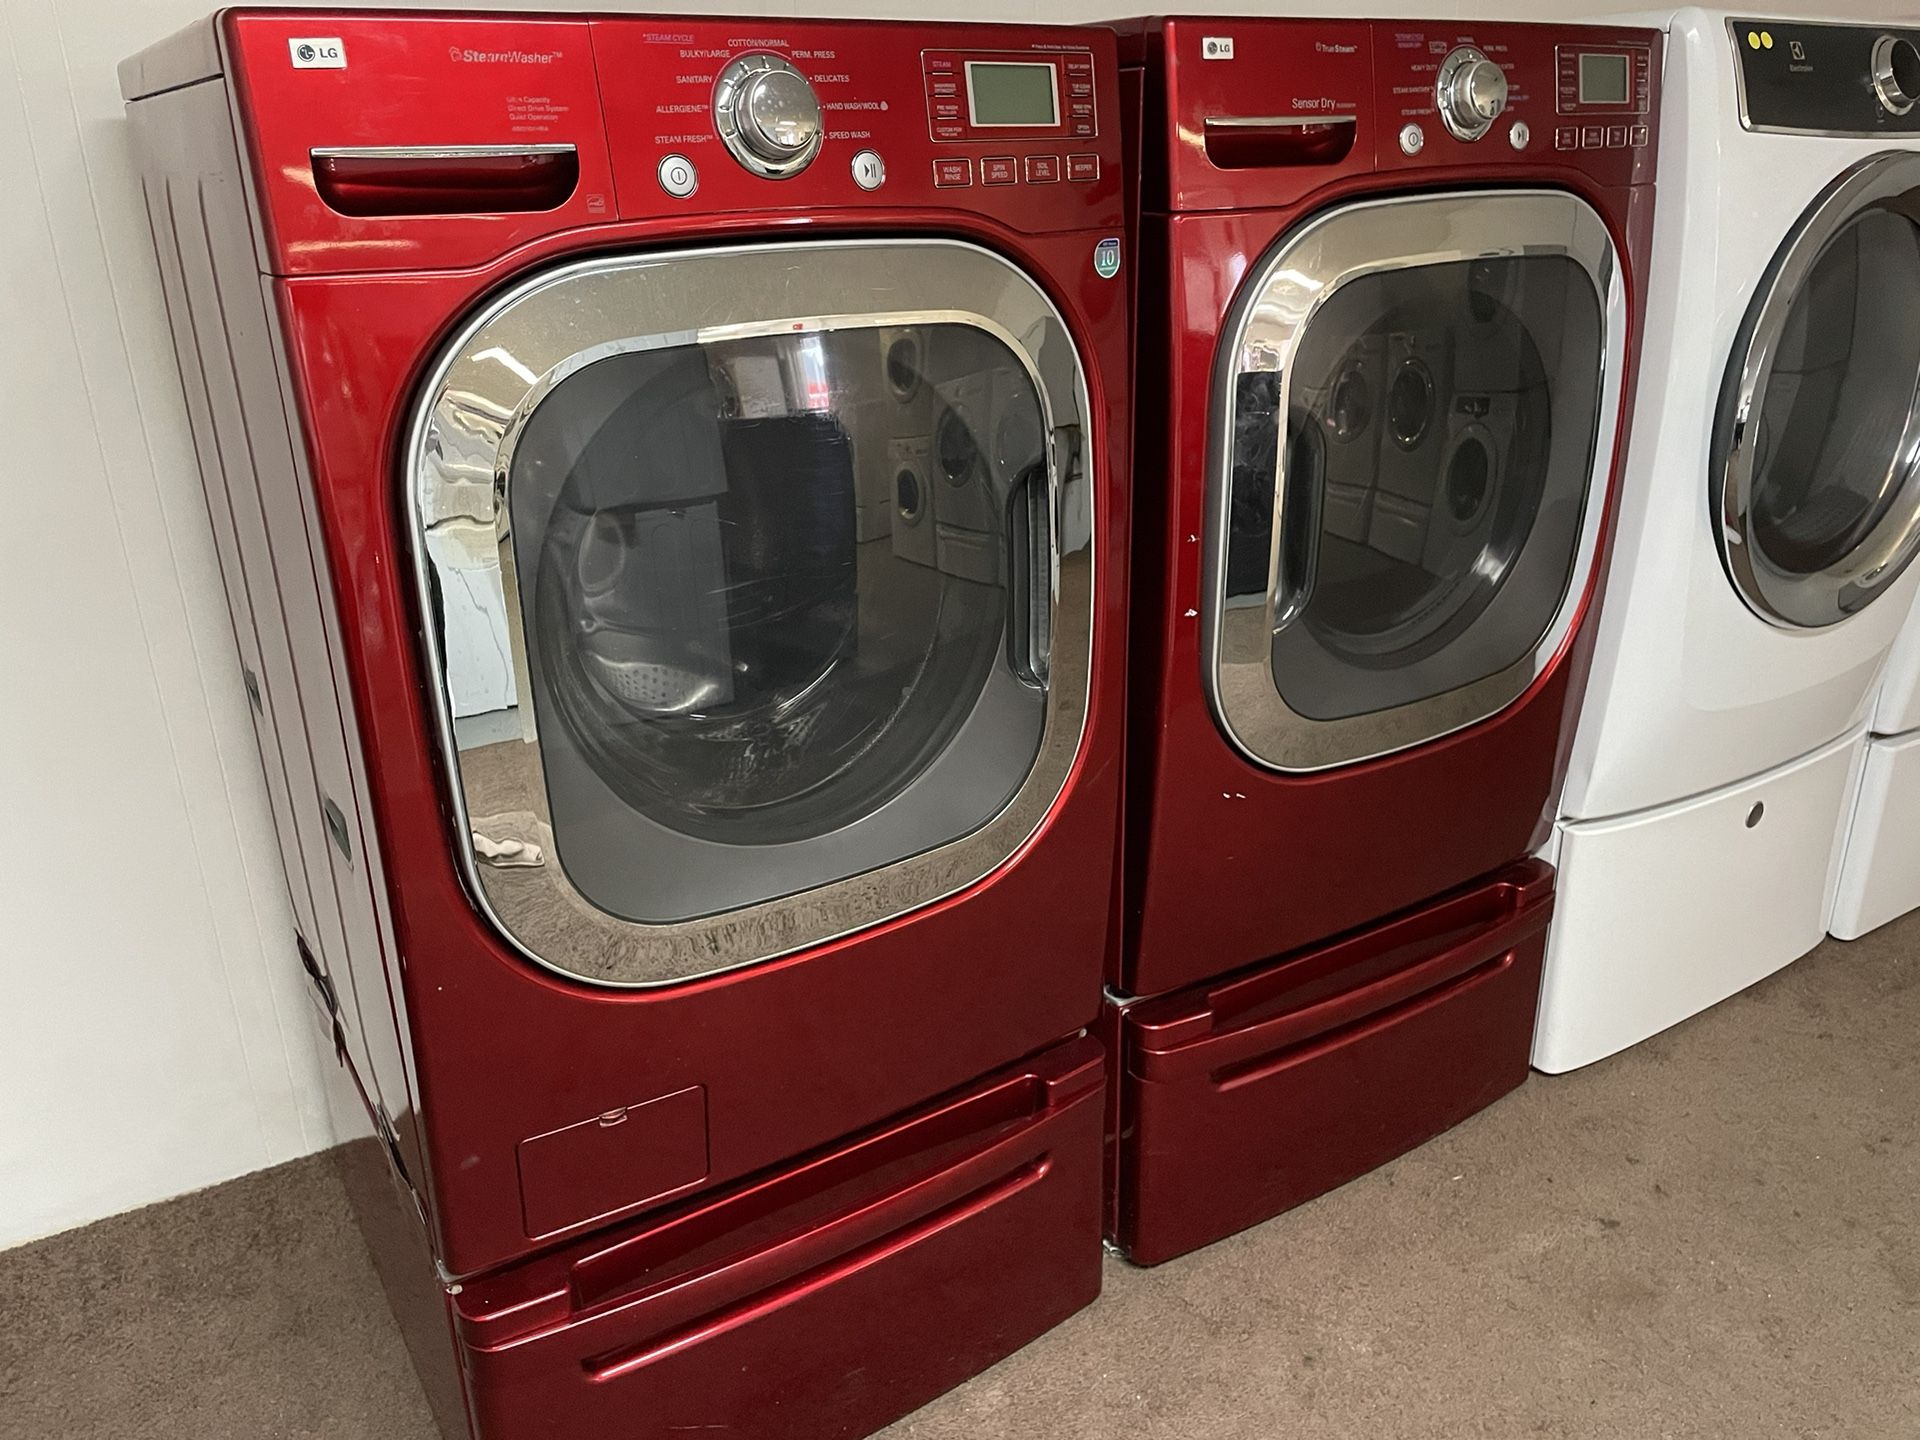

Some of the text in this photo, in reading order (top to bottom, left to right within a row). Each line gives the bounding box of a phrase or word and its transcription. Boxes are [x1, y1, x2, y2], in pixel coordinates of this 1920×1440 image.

[672, 34, 694, 43] CYCLE
[727, 38, 790, 47] COTTON/NORMAL
[319, 47, 338, 58] LG
[1219, 44, 1231, 53] LG
[679, 49, 731, 58] BULKY/LARGE
[813, 50, 836, 59] PRESS
[675, 75, 713, 84] SANITARY
[814, 74, 850, 83] DELICATES
[1291, 97, 1336, 111] Sensor Dry
[654, 135, 682, 144] STEAM
[828, 130, 871, 140] SPEED WASH
[991, 171, 1008, 179] SPEED
[1035, 168, 1050, 177] LEVEL
[1101, 249, 1115, 267] 10
